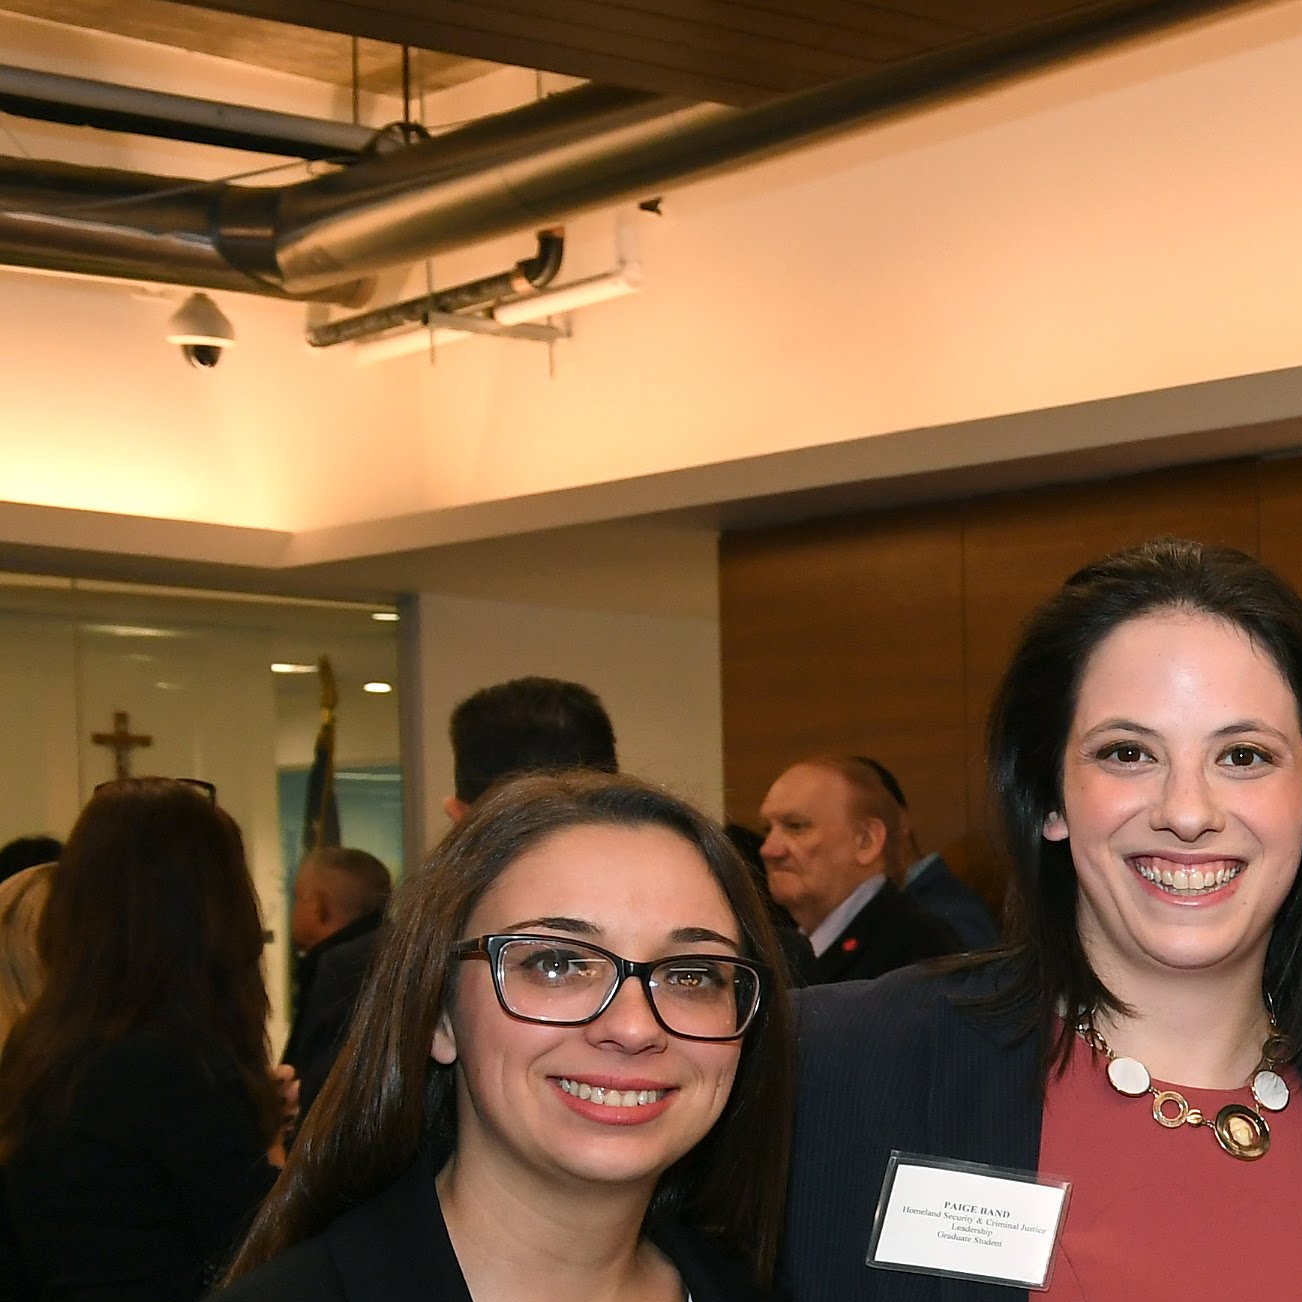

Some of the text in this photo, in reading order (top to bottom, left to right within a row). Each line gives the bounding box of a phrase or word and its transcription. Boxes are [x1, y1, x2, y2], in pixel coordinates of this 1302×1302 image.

[944, 1201, 1010, 1218] PAIGE BAND
[903, 1206, 941, 1217] Homeland
[943, 1212, 973, 1224] Security
[986, 1219, 1019, 1229] Criminal
[1021, 1224, 1046, 1234] Justice
[951, 1223, 993, 1236] Leadership
[937, 1231, 1002, 1247] Graduate Student
